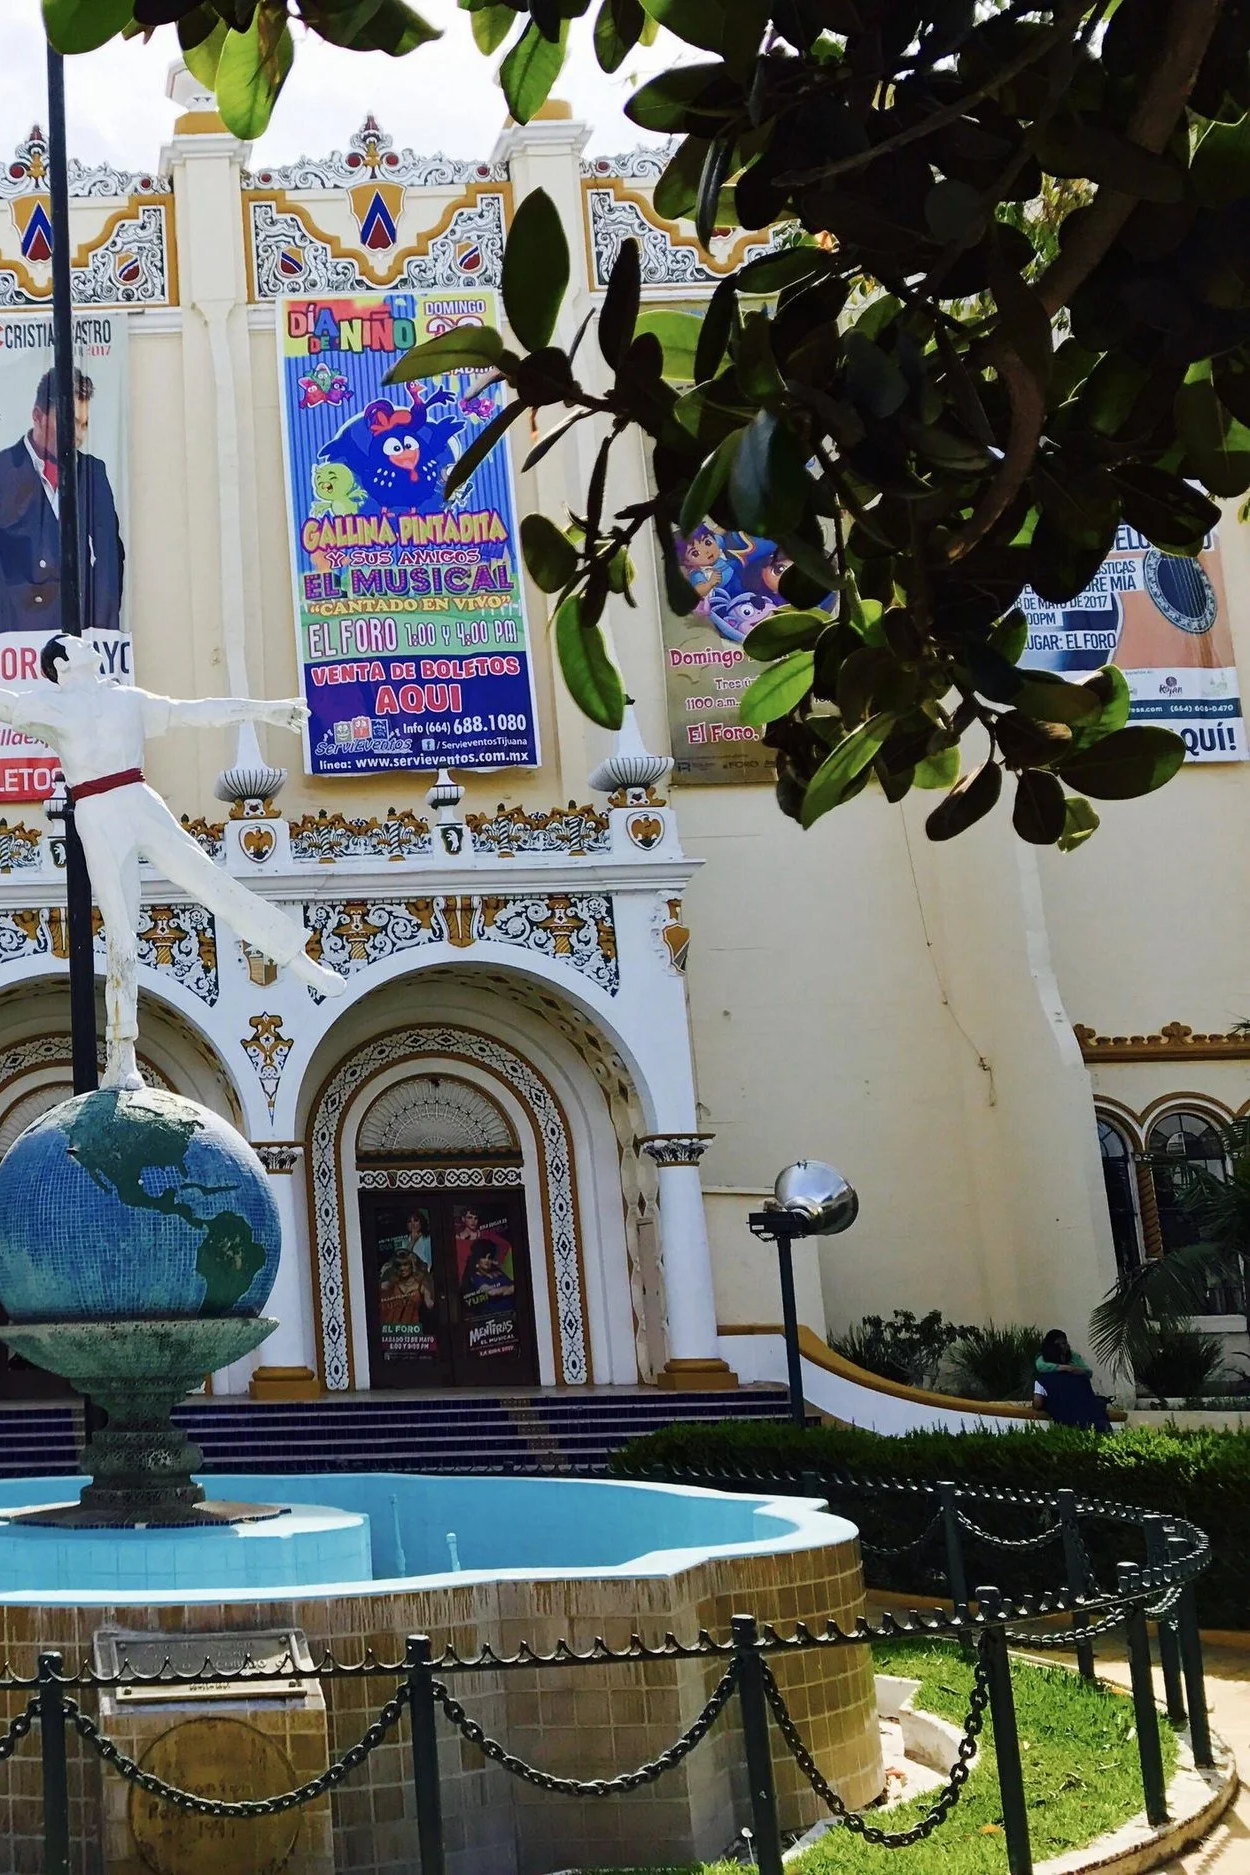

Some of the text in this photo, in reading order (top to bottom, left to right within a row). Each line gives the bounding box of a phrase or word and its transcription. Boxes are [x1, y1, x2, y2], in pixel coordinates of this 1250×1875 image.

[425, 300, 486, 315] DOMINGO
[5, 319, 111, 349] CRISTIA ASTRO
[339, 311, 417, 354] NIÑO
[301, 510, 508, 554] GALLINA PINTADITA
[326, 548, 481, 568] Y SUS AMIGOS
[1097, 560, 1137, 575] STICAS
[303, 564, 515, 600] EL MUSICAL
[423, 596, 450, 611] EN
[1024, 597, 1037, 610] DE
[1070, 596, 1083, 608] DE
[1084, 595, 1107, 608] 2017
[1026, 612, 1056, 625] 00PM
[308, 617, 398, 659] EL FORO
[405, 622, 437, 647] 1:00
[456, 620, 488, 646] 4:00
[494, 619, 518, 644] PM
[1025, 633, 1117, 650] UGAR: EL FORO
[669, 648, 744, 668] Domingo
[311, 656, 520, 687] VENTA DE BOLETOS
[715, 678, 741, 690] Tres
[375, 684, 463, 715] AQUI
[403, 714, 527, 736] Info (664) 688.1080
[687, 722, 760, 744] El Foro.
[1180, 722, 1237, 756] QUÍ!
[320, 751, 529, 771] línea: www.servieventos.com.mx
[395, 1325, 421, 1333] FORO
